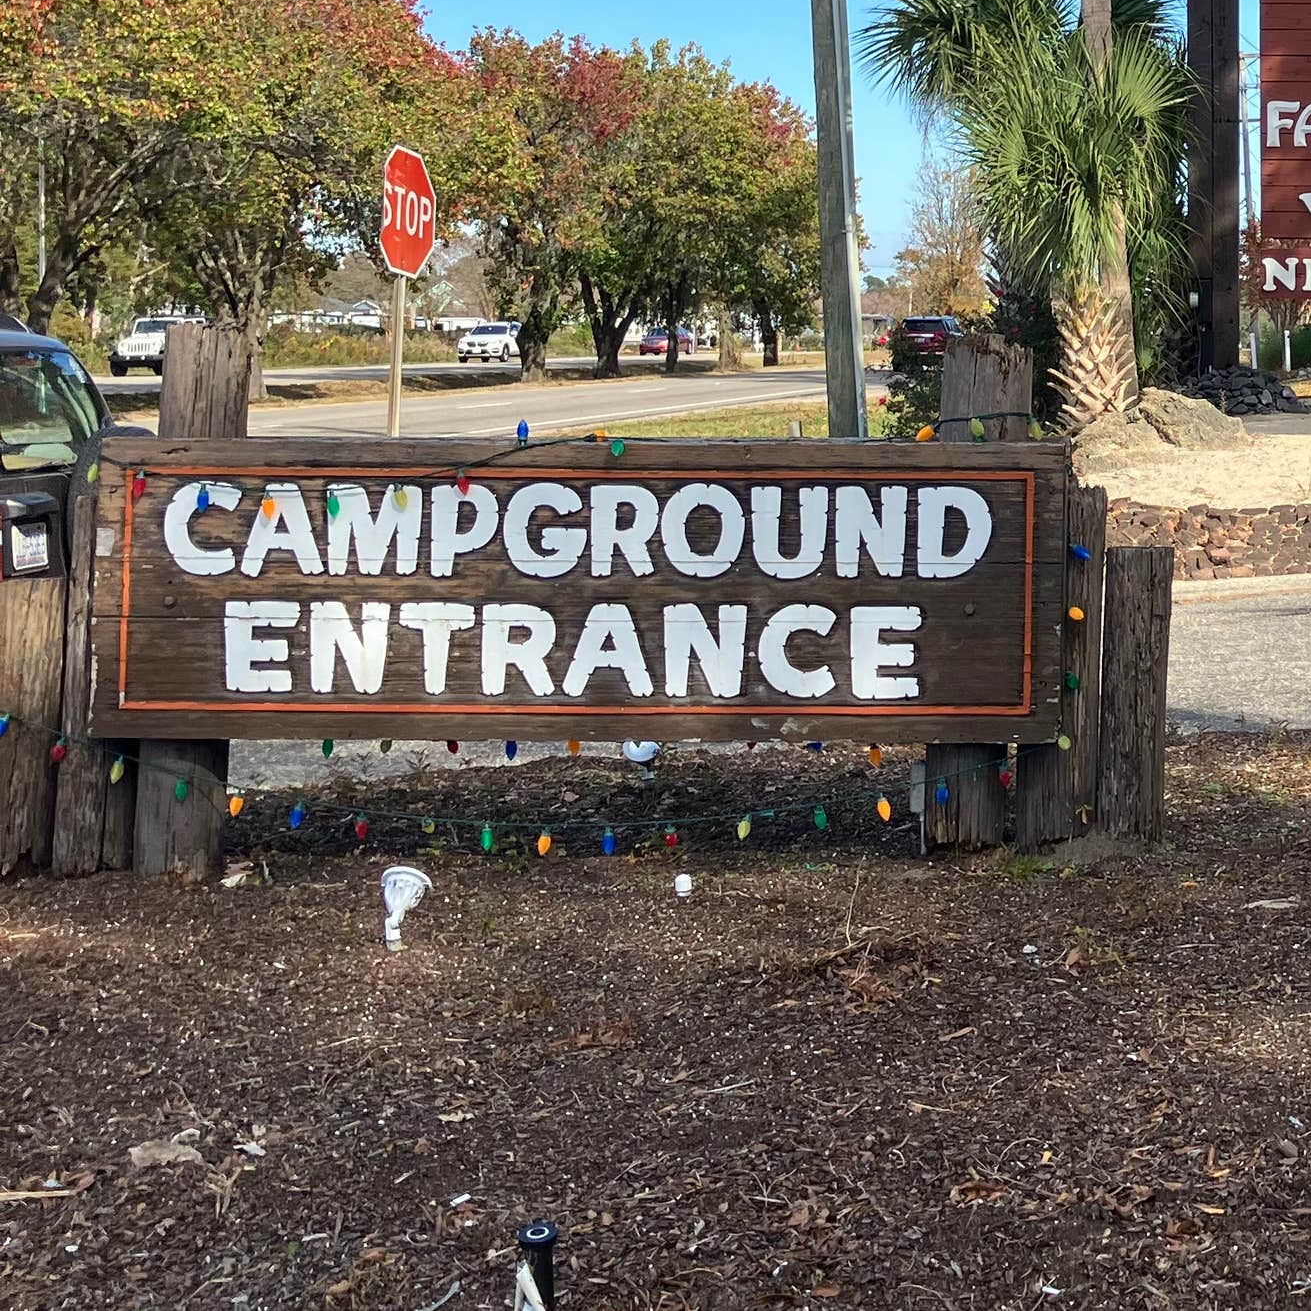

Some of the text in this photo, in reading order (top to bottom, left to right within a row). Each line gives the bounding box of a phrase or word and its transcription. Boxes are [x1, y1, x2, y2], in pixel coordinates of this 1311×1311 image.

[384, 180, 432, 239] STOP
[162, 481, 993, 580] CAMPGROUND
[223, 600, 923, 700] ENTRANCE
